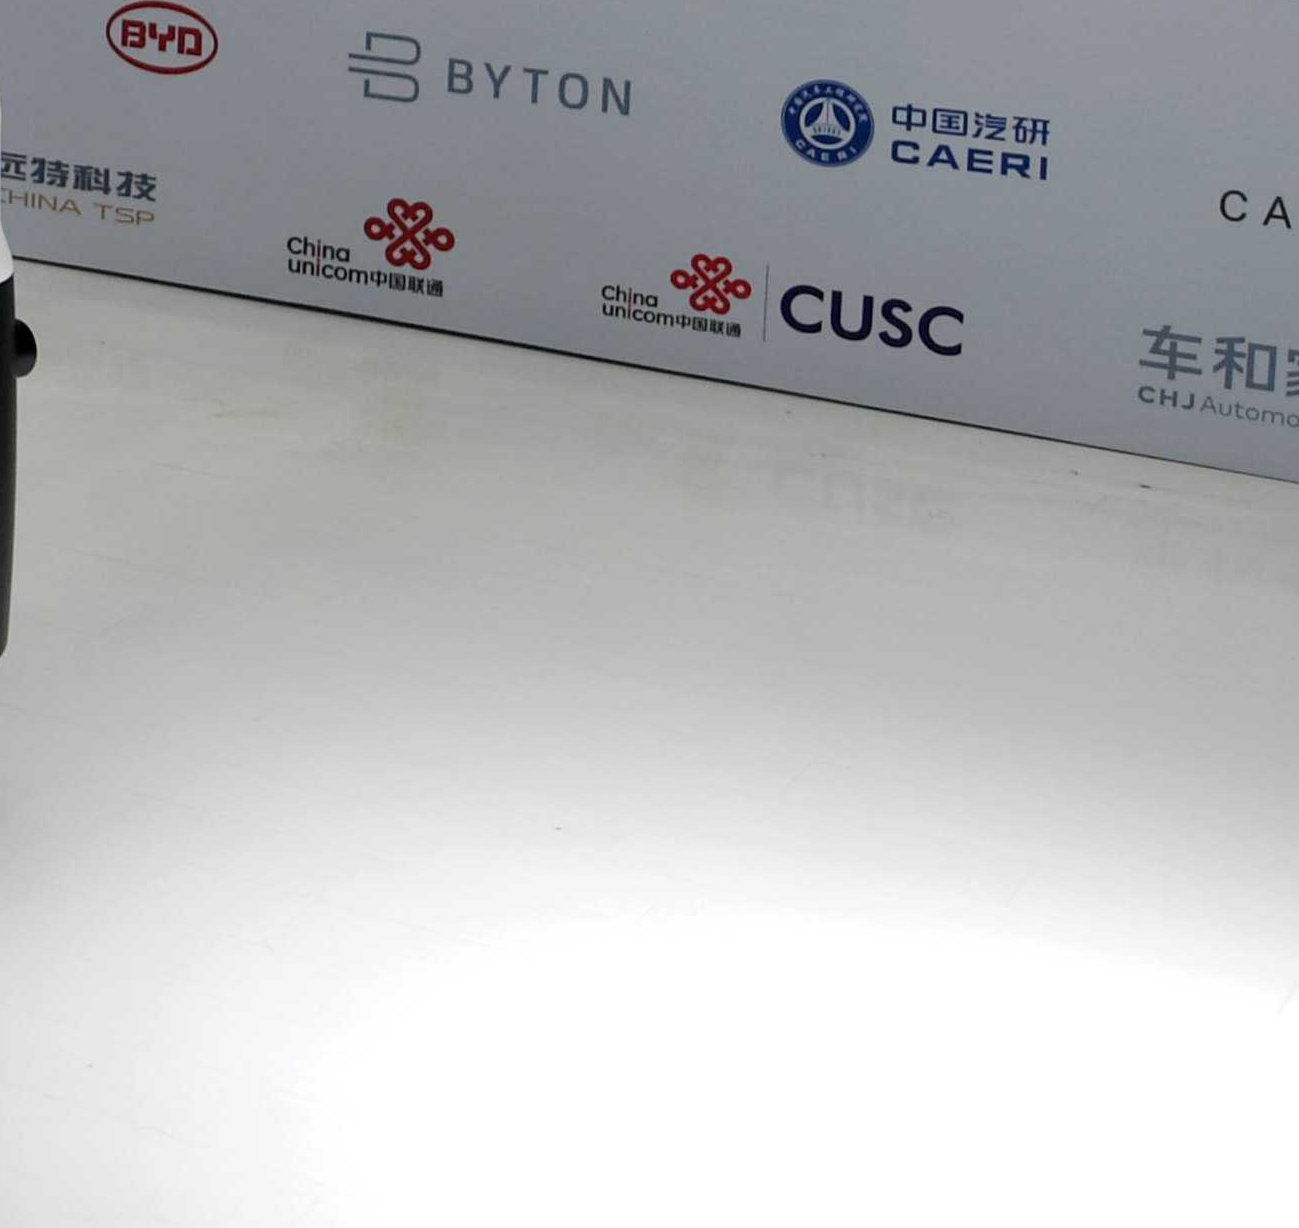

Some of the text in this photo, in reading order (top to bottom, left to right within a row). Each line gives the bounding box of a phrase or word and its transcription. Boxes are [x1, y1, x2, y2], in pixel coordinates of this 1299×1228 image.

[120, 19, 204, 57] BYD
[446, 57, 633, 117] BYTON
[890, 103, 1051, 147] 中国汽研
[890, 138, 1049, 181] CAERI
[93, 202, 156, 227] TSP
[286, 235, 351, 263] China
[286, 256, 445, 298] unicom 中国联通
[601, 284, 659, 309] China
[601, 303, 742, 339] unicom 中国联通
[780, 283, 965, 357] CUSC
[1137, 385, 1196, 411] CHJ
